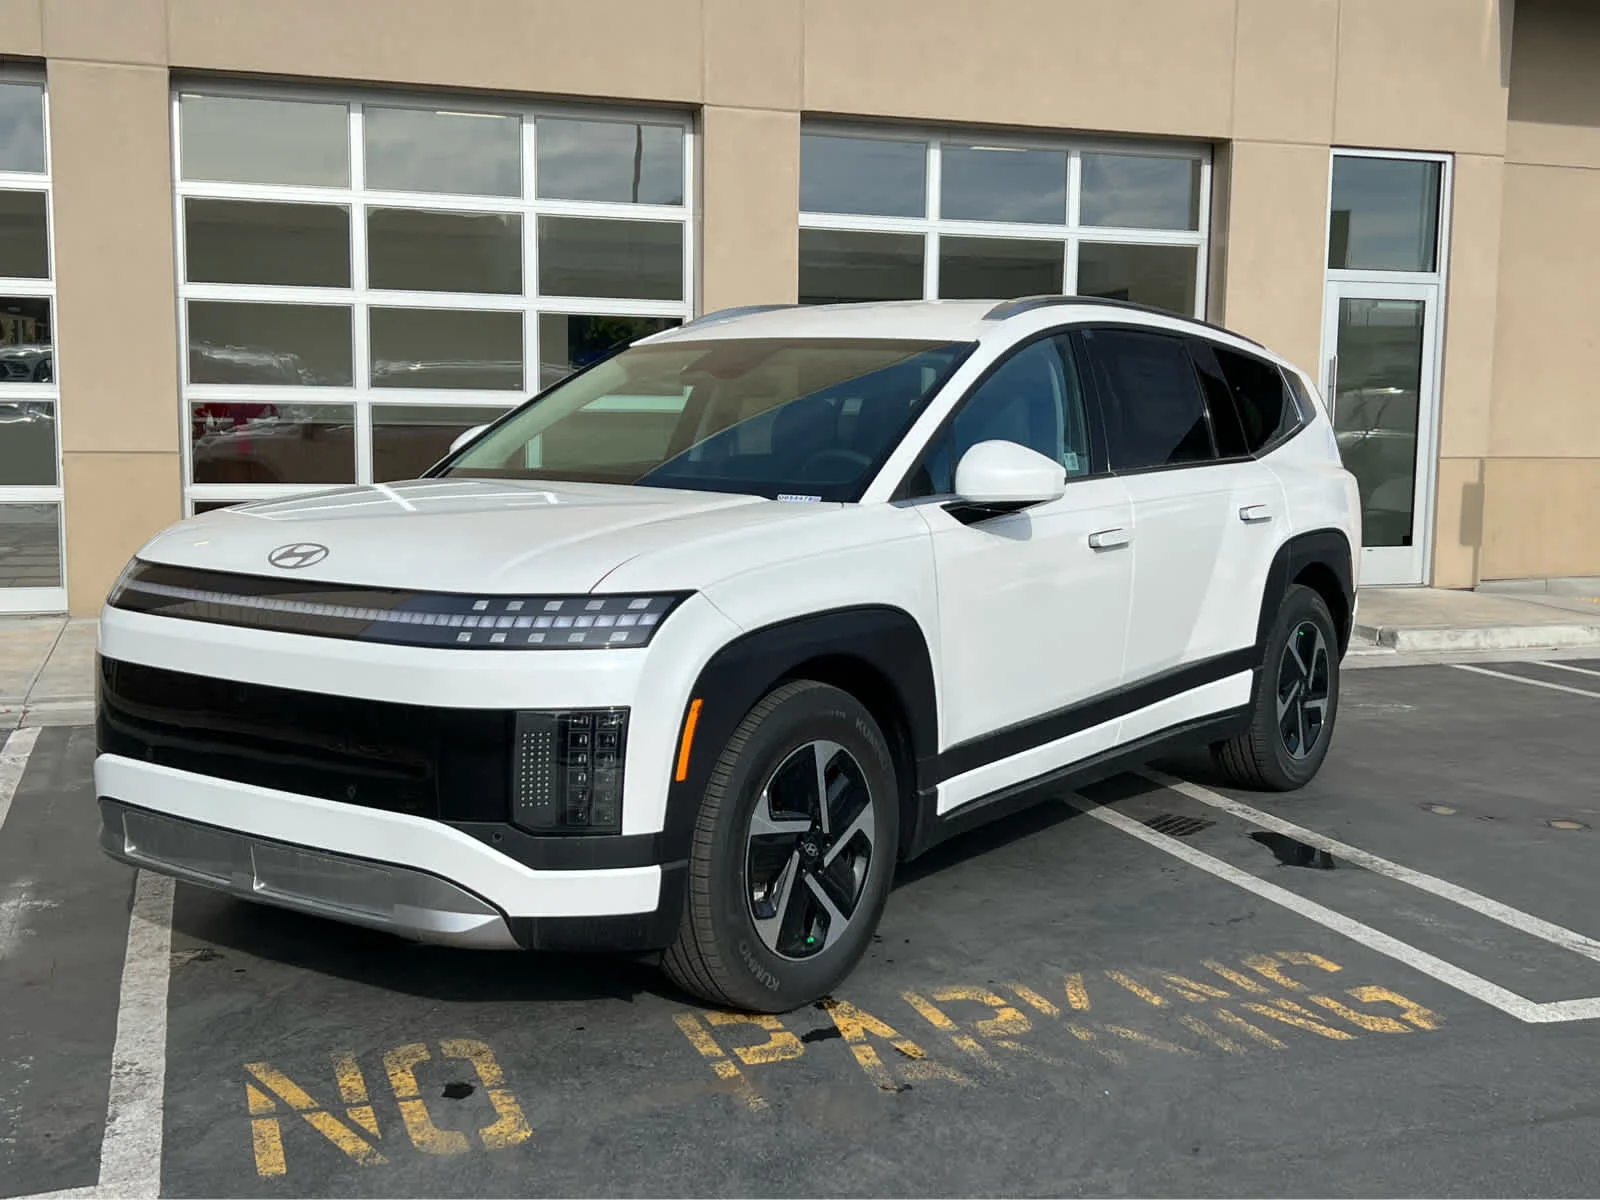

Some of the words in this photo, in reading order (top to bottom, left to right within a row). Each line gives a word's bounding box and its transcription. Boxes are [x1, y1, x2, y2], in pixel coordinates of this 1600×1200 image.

[738, 941, 780, 992] KUMHO
[244, 1039, 532, 1177] NO
[672, 950, 1445, 1112] PARKING
